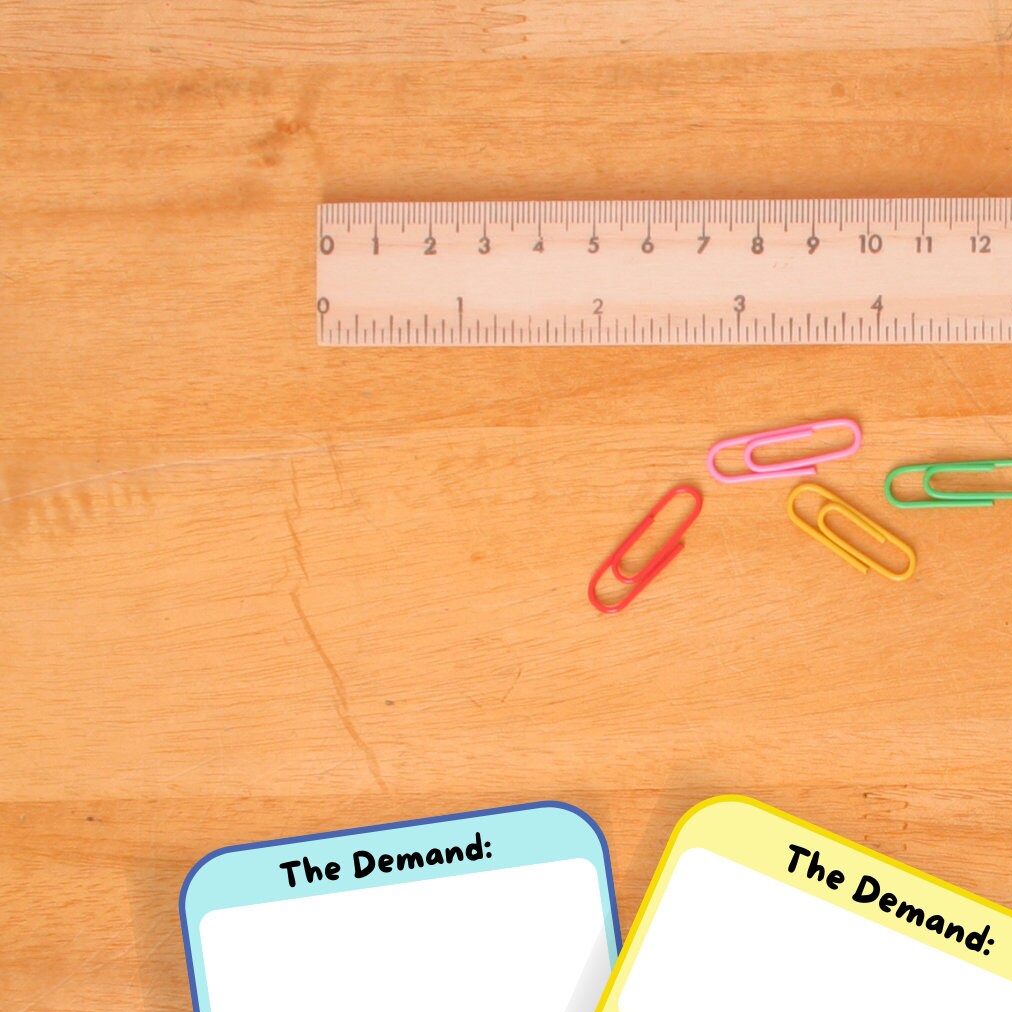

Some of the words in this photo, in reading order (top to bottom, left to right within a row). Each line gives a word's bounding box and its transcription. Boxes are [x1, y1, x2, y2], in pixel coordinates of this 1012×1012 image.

[319, 235, 335, 256] 0
[371, 236, 380, 256] 1
[423, 235, 438, 256] 2
[478, 235, 491, 255] 3
[532, 236, 545, 254] 4
[587, 236, 600, 255] 5
[641, 235, 655, 255] 6
[697, 235, 711, 255] 7
[751, 235, 765, 255] 8
[806, 235, 820, 255] 9
[858, 234, 884, 254] 10
[914, 235, 934, 255] 11
[969, 234, 992, 254] 12
[316, 296, 330, 316] 0
[456, 296, 464, 314] 1
[592, 298, 604, 316] 2
[733, 294, 746, 315] 3
[870, 295, 885, 314] 4
[279, 856, 341, 888] The
[352, 831, 493, 879] Demand:
[786, 843, 846, 891] The
[851, 874, 995, 956] Demand:
